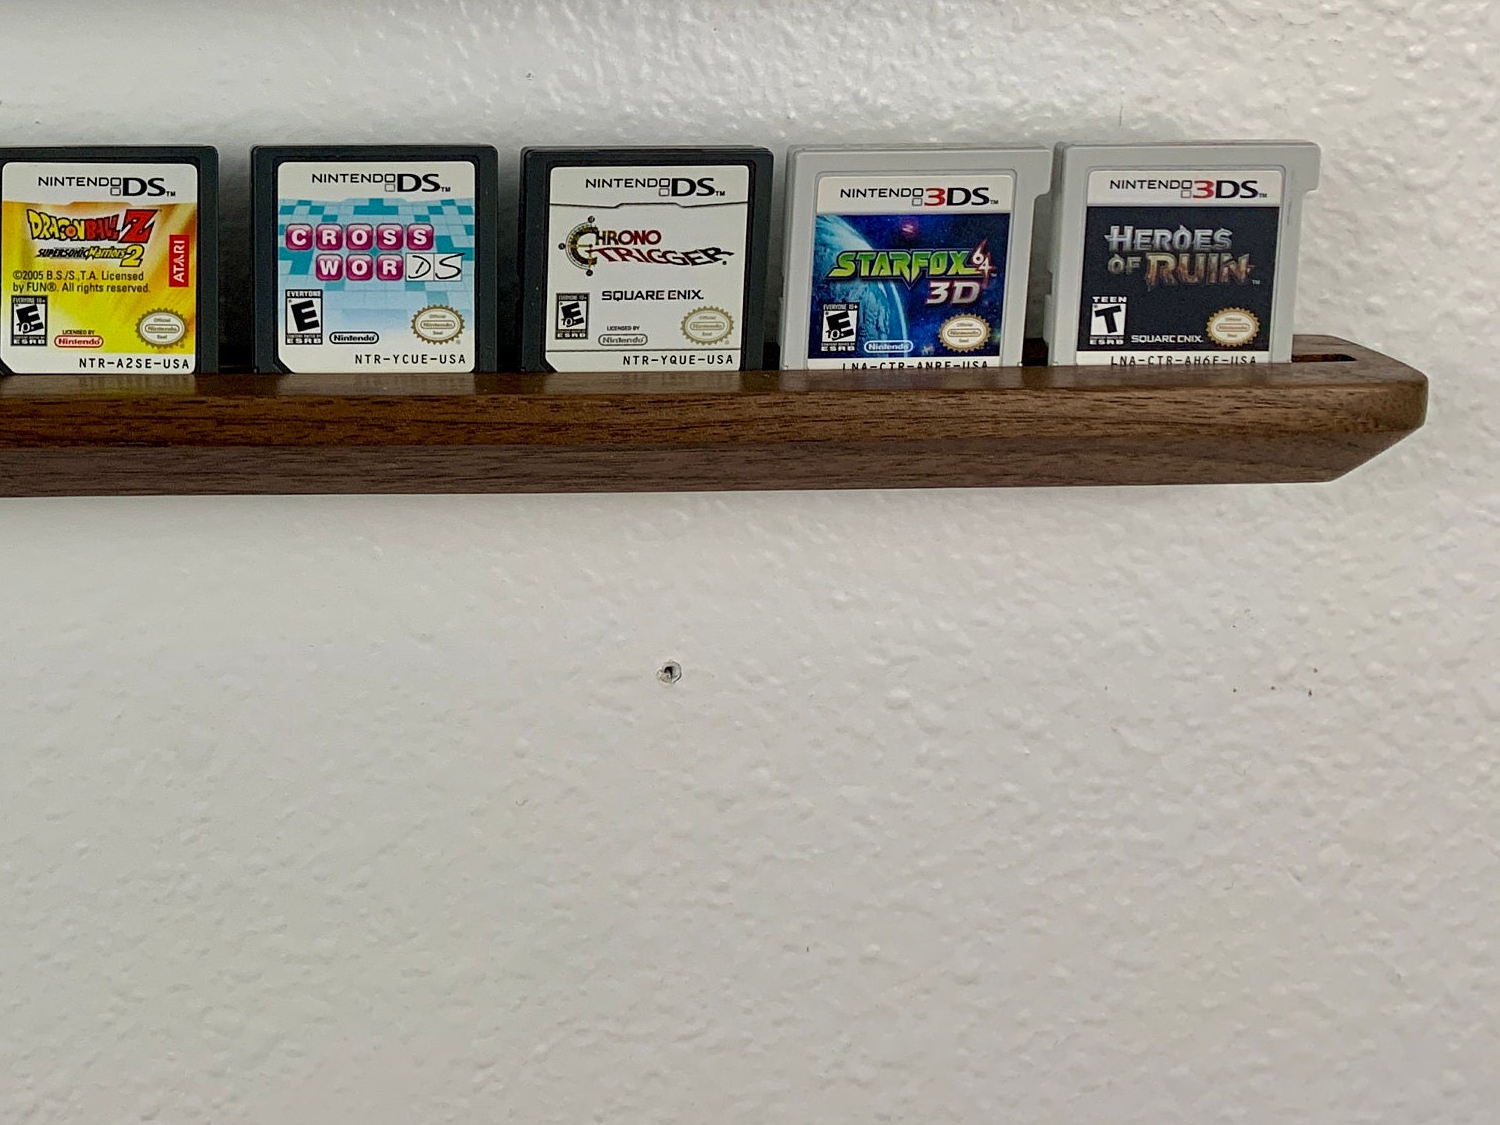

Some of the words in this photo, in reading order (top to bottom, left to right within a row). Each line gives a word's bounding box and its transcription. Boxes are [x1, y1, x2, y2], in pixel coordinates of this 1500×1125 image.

[38, 177, 121, 187] NINTENDO
[312, 174, 395, 183] NINTENDO
[586, 178, 670, 188] NINTENDO
[1110, 180, 1192, 190] NINTENDO
[840, 188, 923, 198] NINTENDO
[291, 229, 427, 245] CROSS
[1104, 225, 1233, 252] HEROES
[120, 244, 145, 267] 2
[173, 240, 185, 282] ATARI
[1108, 254, 1142, 275] OF
[102, 271, 144, 280] Licensed
[13, 283, 23, 294] by
[62, 282, 74, 292] All
[77, 283, 103, 294] rights
[106, 283, 150, 293] reserved.
[926, 281, 980, 304] 3D
[602, 291, 664, 301] SQUARE
[79, 358, 189, 368] NTR-A2SE-USA
[355, 355, 466, 364] NTR-YCUE-USA
[623, 355, 733, 365] NTR-YQUE-USA
